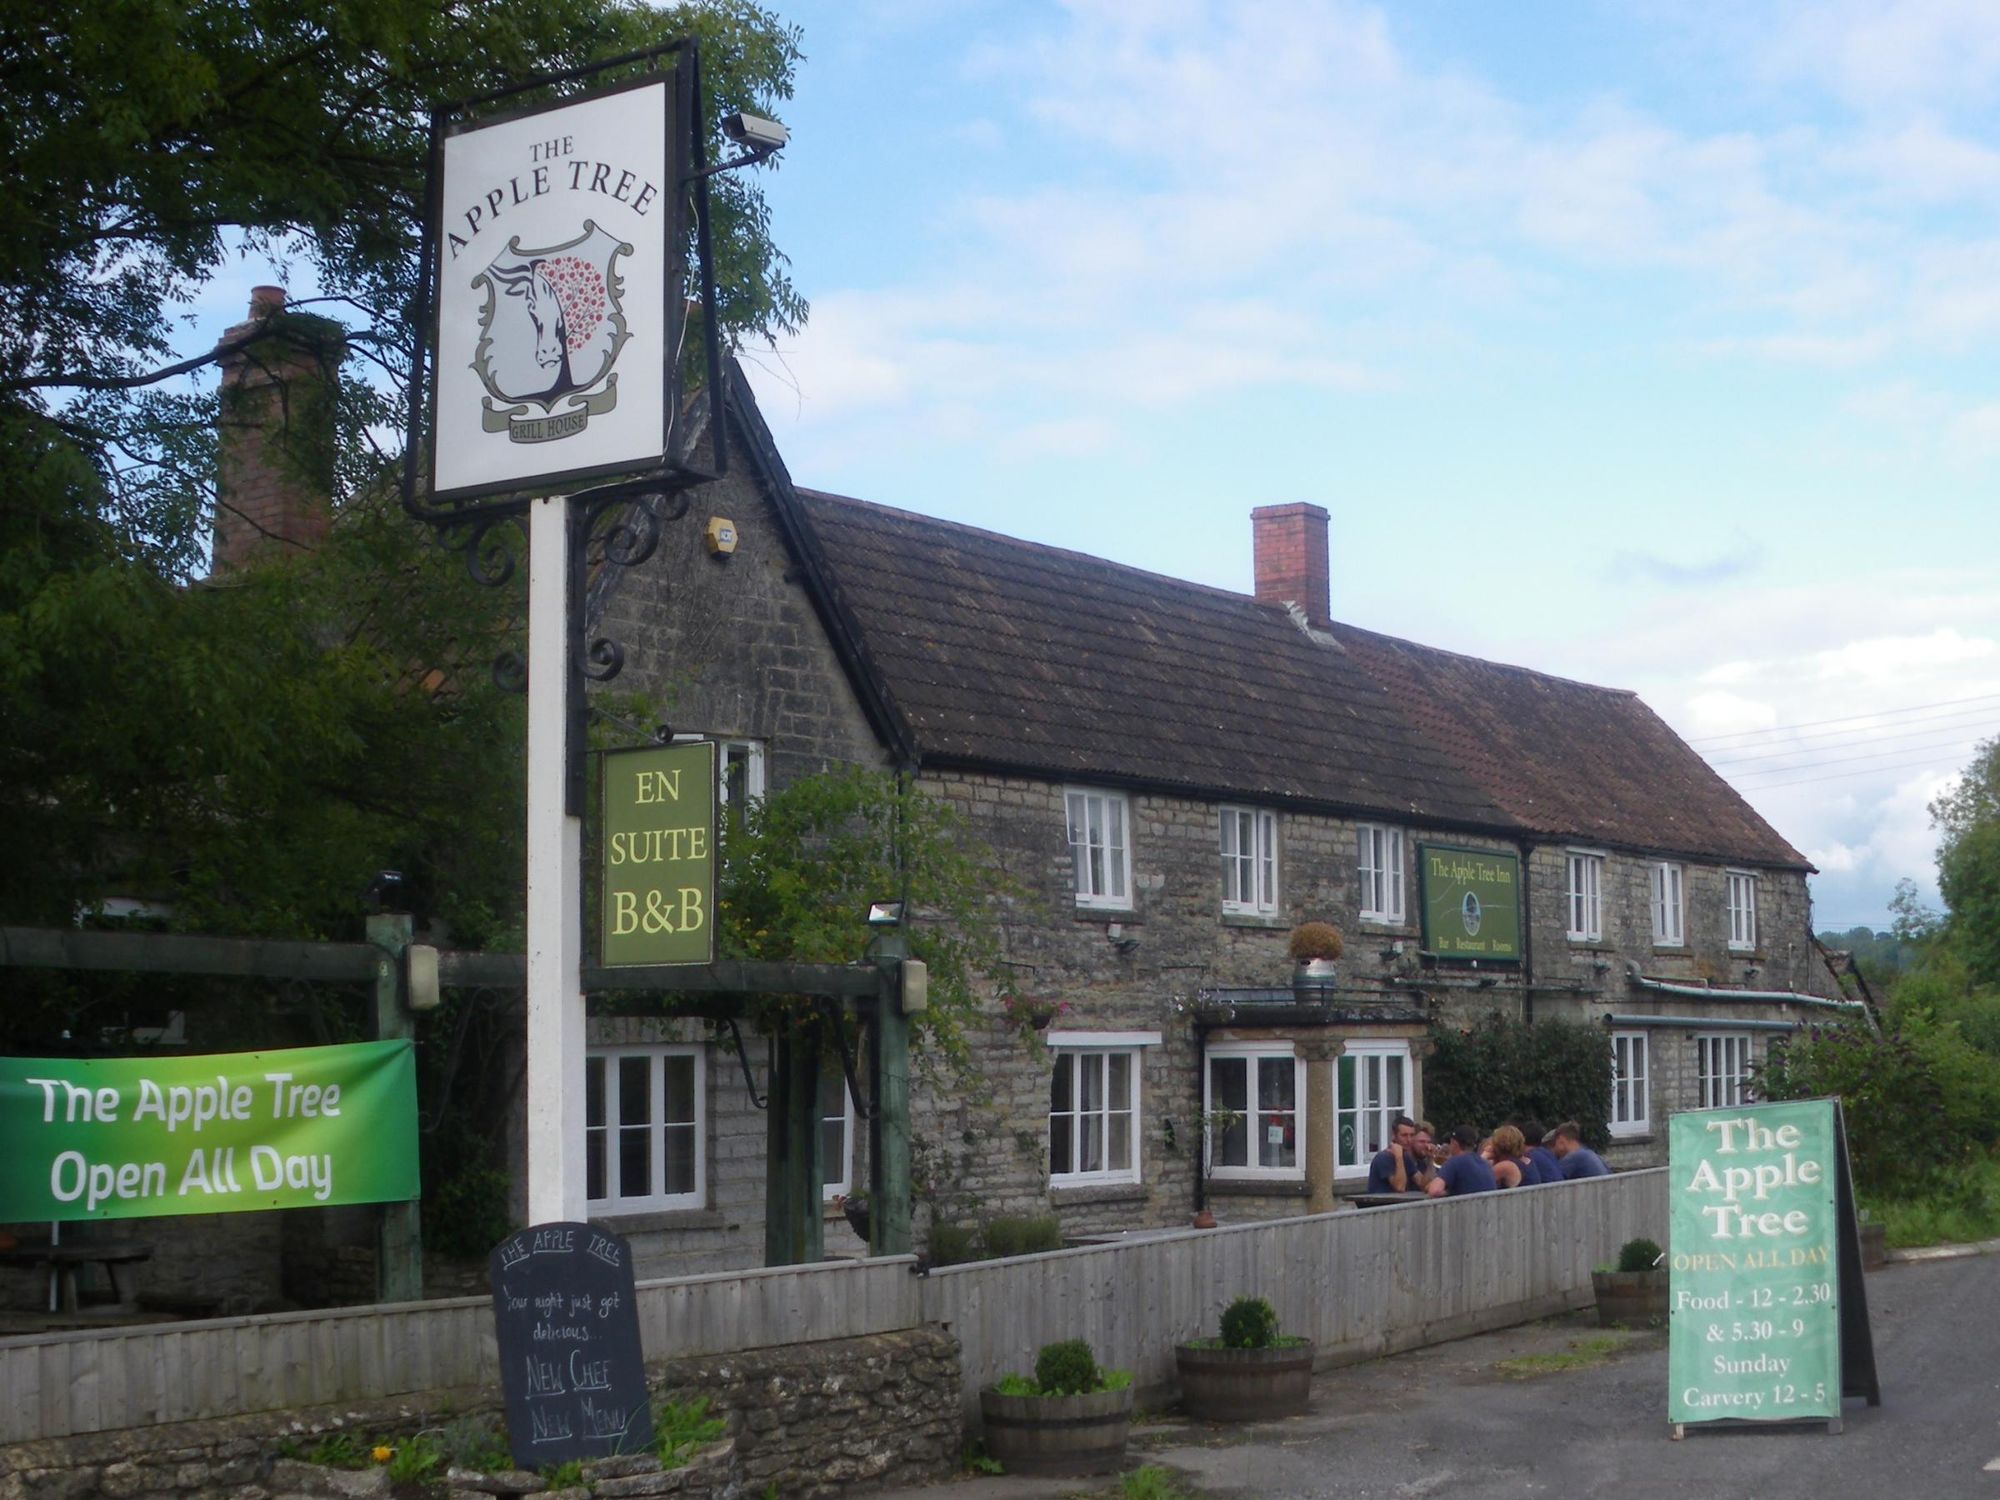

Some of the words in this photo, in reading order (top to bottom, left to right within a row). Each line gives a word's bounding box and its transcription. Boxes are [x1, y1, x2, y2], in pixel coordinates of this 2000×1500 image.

[529, 135, 574, 162] THE
[447, 165, 551, 261] APPLE
[568, 160, 658, 217] TREE
[511, 422, 544, 439] GRILL
[547, 414, 584, 437] HOUSE
[635, 769, 682, 804] EN
[610, 827, 708, 865] SUITE
[1431, 857, 1449, 877] The
[1450, 860, 1475, 885] Apple
[611, 887, 704, 935] B&B
[26, 1078, 119, 1122] The
[133, 1076, 253, 1131] Apple
[264, 1073, 341, 1119] Tree
[1707, 1117, 1801, 1153] The
[51, 1150, 166, 1211] Open
[178, 1147, 241, 1196] All
[250, 1145, 332, 1200] Day
[1686, 1152, 1822, 1200] Apple
[1702, 1203, 1808, 1238] Tree
[500, 1236, 526, 1265] THE
[533, 1230, 575, 1250] APPLE
[588, 1233, 622, 1264] TREE
[1673, 1253, 1736, 1271] OPEN
[1743, 1250, 1786, 1268] ALL
[1791, 1246, 1832, 1265] DAY
[535, 1291, 564, 1318] night
[568, 1293, 592, 1318] just
[598, 1291, 620, 1318] got
[1677, 1291, 1729, 1310] Food
[1751, 1288, 1773, 1308] 12
[1793, 1283, 1831, 1305] 2.30
[1706, 1324, 1724, 1343] &
[1732, 1321, 1773, 1341] 5.30
[1793, 1319, 1804, 1338] 9
[1714, 1354, 1791, 1378] Sunday
[1683, 1387, 1766, 1410] Carvery
[1774, 1385, 1795, 1403] 12
[1815, 1383, 1825, 1402] 5
